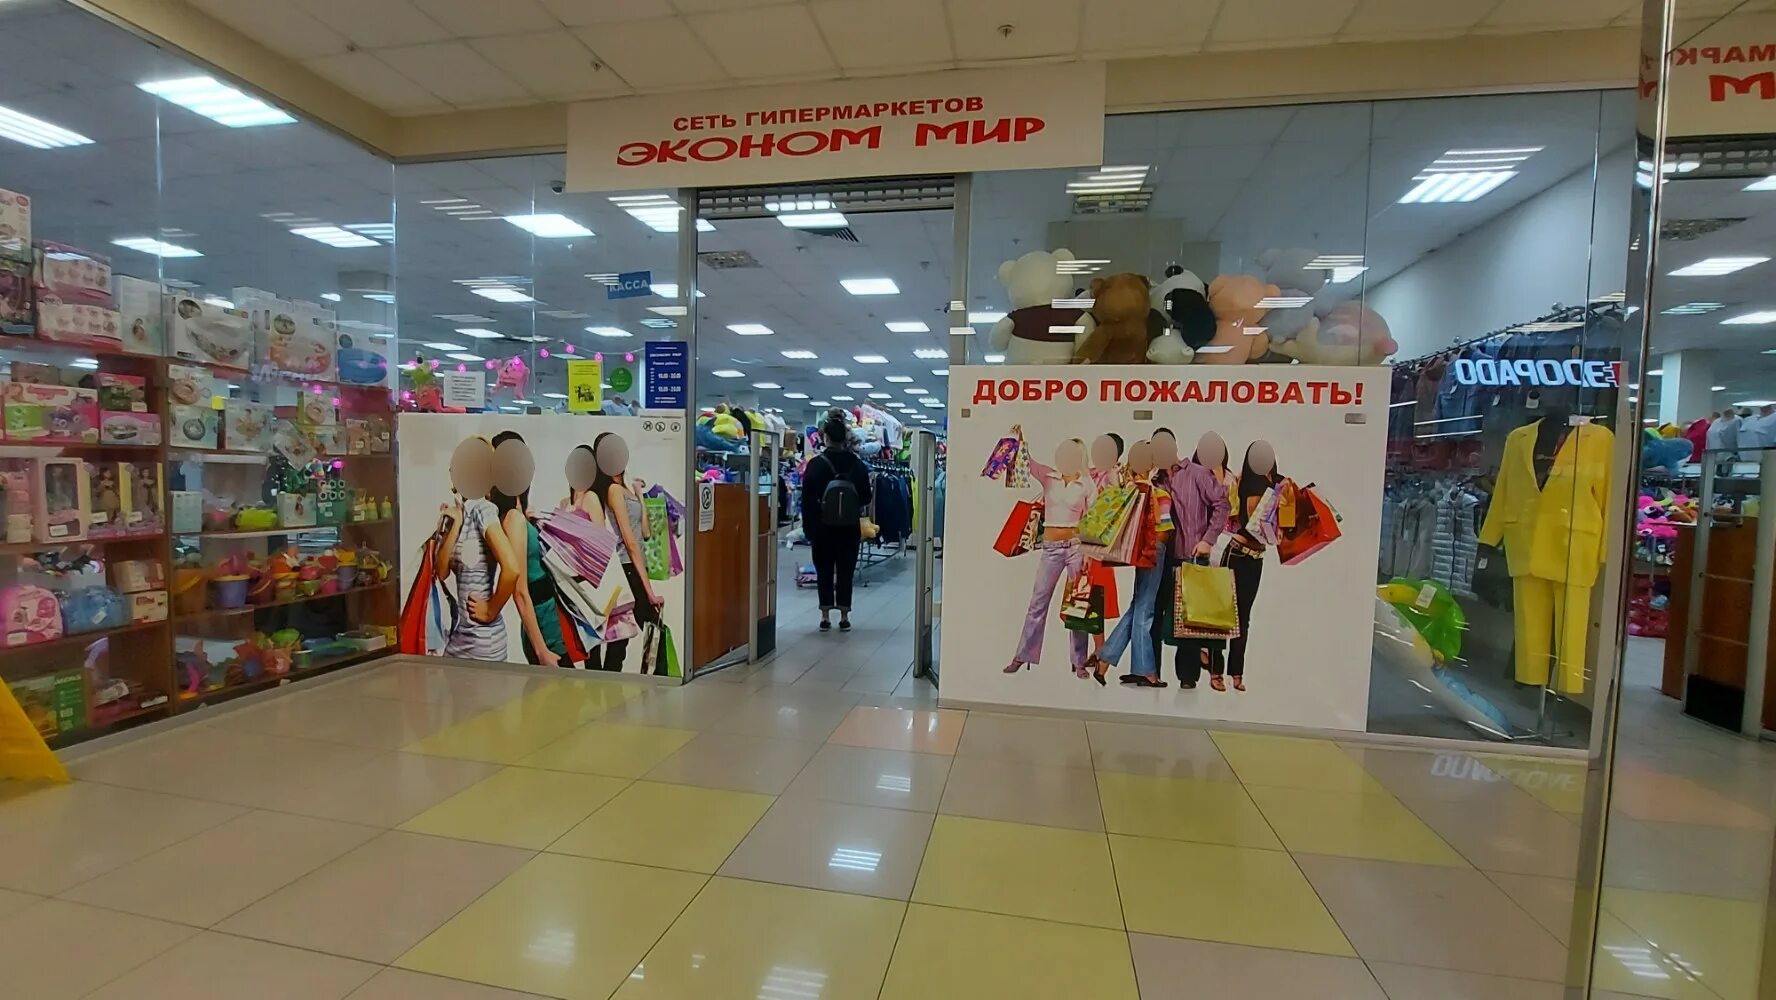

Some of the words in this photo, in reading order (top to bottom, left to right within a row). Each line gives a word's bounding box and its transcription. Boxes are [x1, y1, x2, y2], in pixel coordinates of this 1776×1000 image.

[673, 114, 737, 131] СЕТЬ
[745, 97, 984, 126] ГИПЕРМАРКЕТОВ
[617, 126, 882, 166] ЭКОНОМ
[915, 117, 1045, 146] МИР
[973, 379, 1088, 405] ДОБРО
[1100, 380, 1364, 405] ПОЖАЛОВАТЬ!
